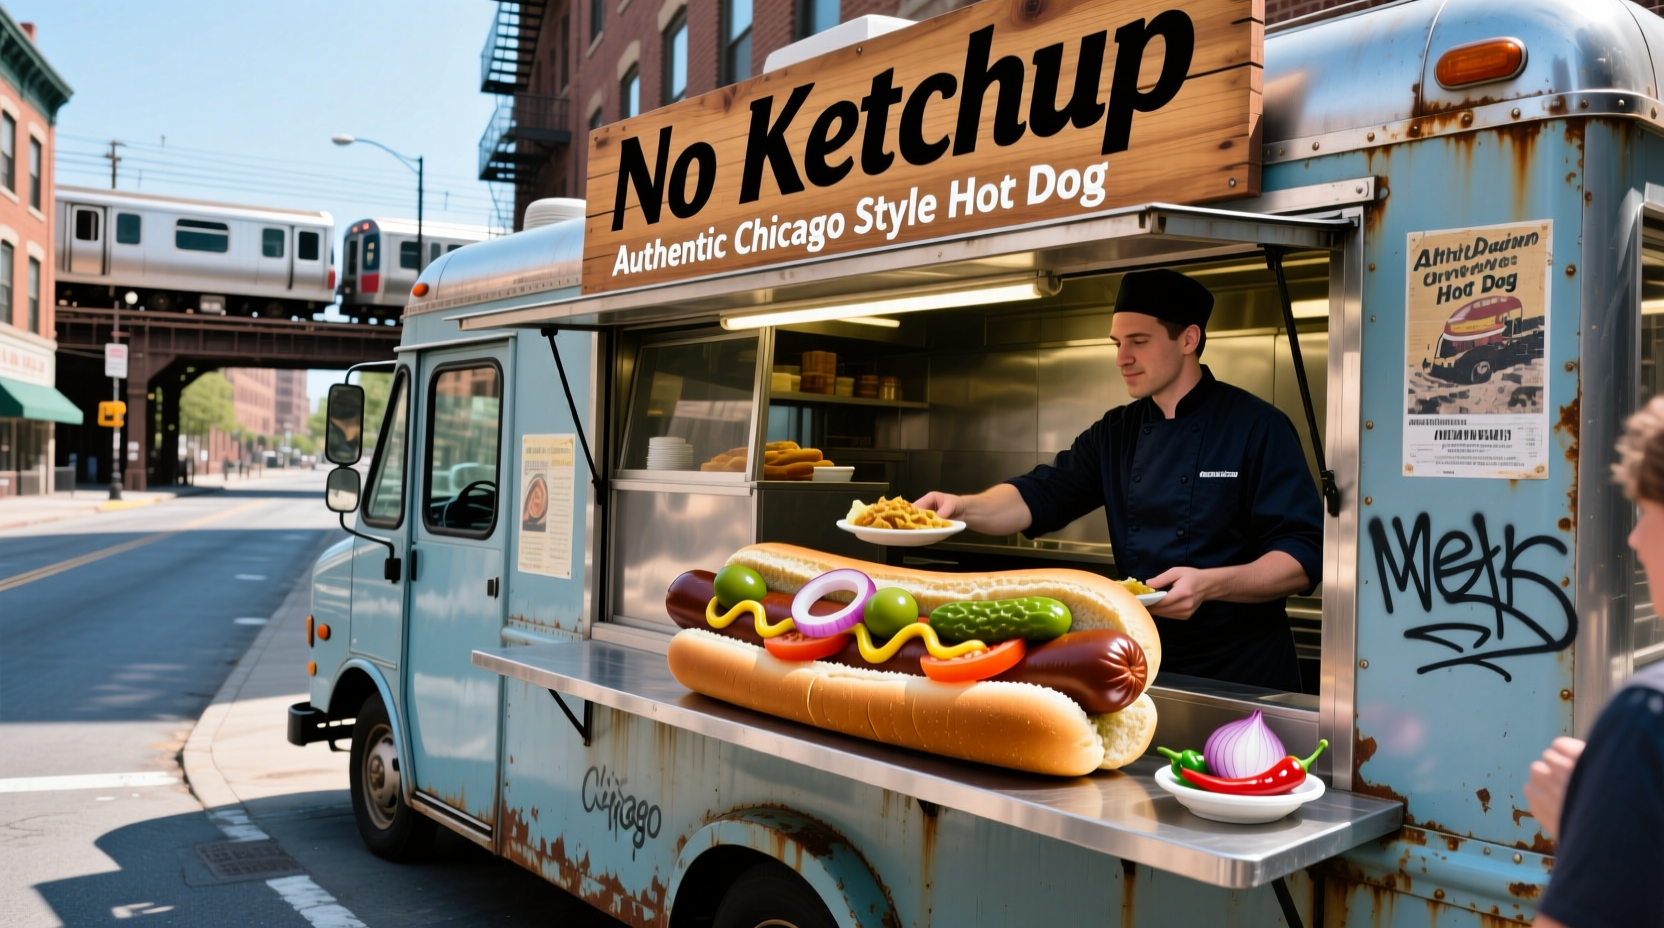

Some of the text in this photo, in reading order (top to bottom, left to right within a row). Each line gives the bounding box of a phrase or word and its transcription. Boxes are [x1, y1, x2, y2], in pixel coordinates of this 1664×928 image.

[611, 9, 1195, 232] No Ketchup
[611, 161, 1109, 277] Authentic Chicago Style Hot Dog
[1481, 272, 1518, 294] Dog
